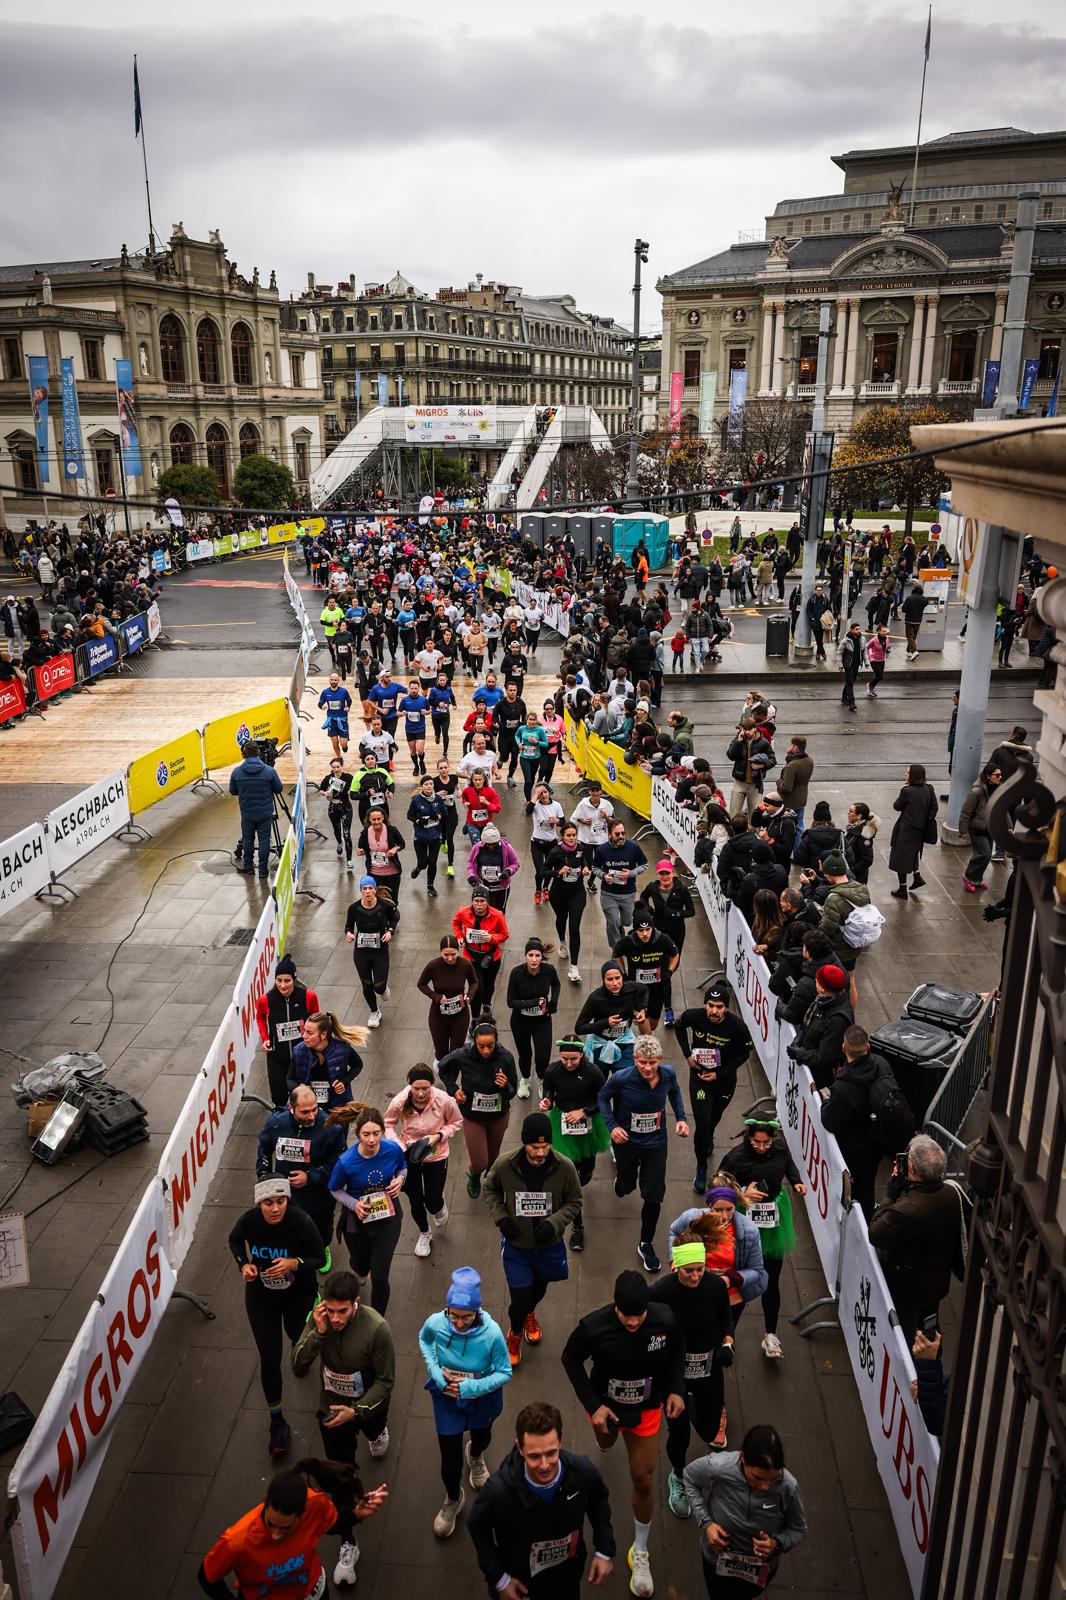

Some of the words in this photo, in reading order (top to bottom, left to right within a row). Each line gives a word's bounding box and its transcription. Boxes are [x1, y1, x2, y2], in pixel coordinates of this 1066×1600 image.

[415, 408, 448, 417] MIGROS
[467, 408, 484, 417] UBS
[90, 643, 108, 657] Tribune
[252, 721, 271, 732] Section
[169, 756, 185, 768] Section
[170, 764, 186, 777] Genève
[54, 780, 124, 843] AESCHBACH
[76, 814, 111, 847] A1904.CH
[653, 782, 696, 843] AESCHBACH
[241, 922, 275, 1048] MIGROS
[745, 957, 769, 1042] UBS
[171, 1042, 237, 1230] MIGROS
[801, 1096, 830, 1220] UBS
[33, 1230, 162, 1556] MIGROS
[879, 1343, 931, 1554] UBS
